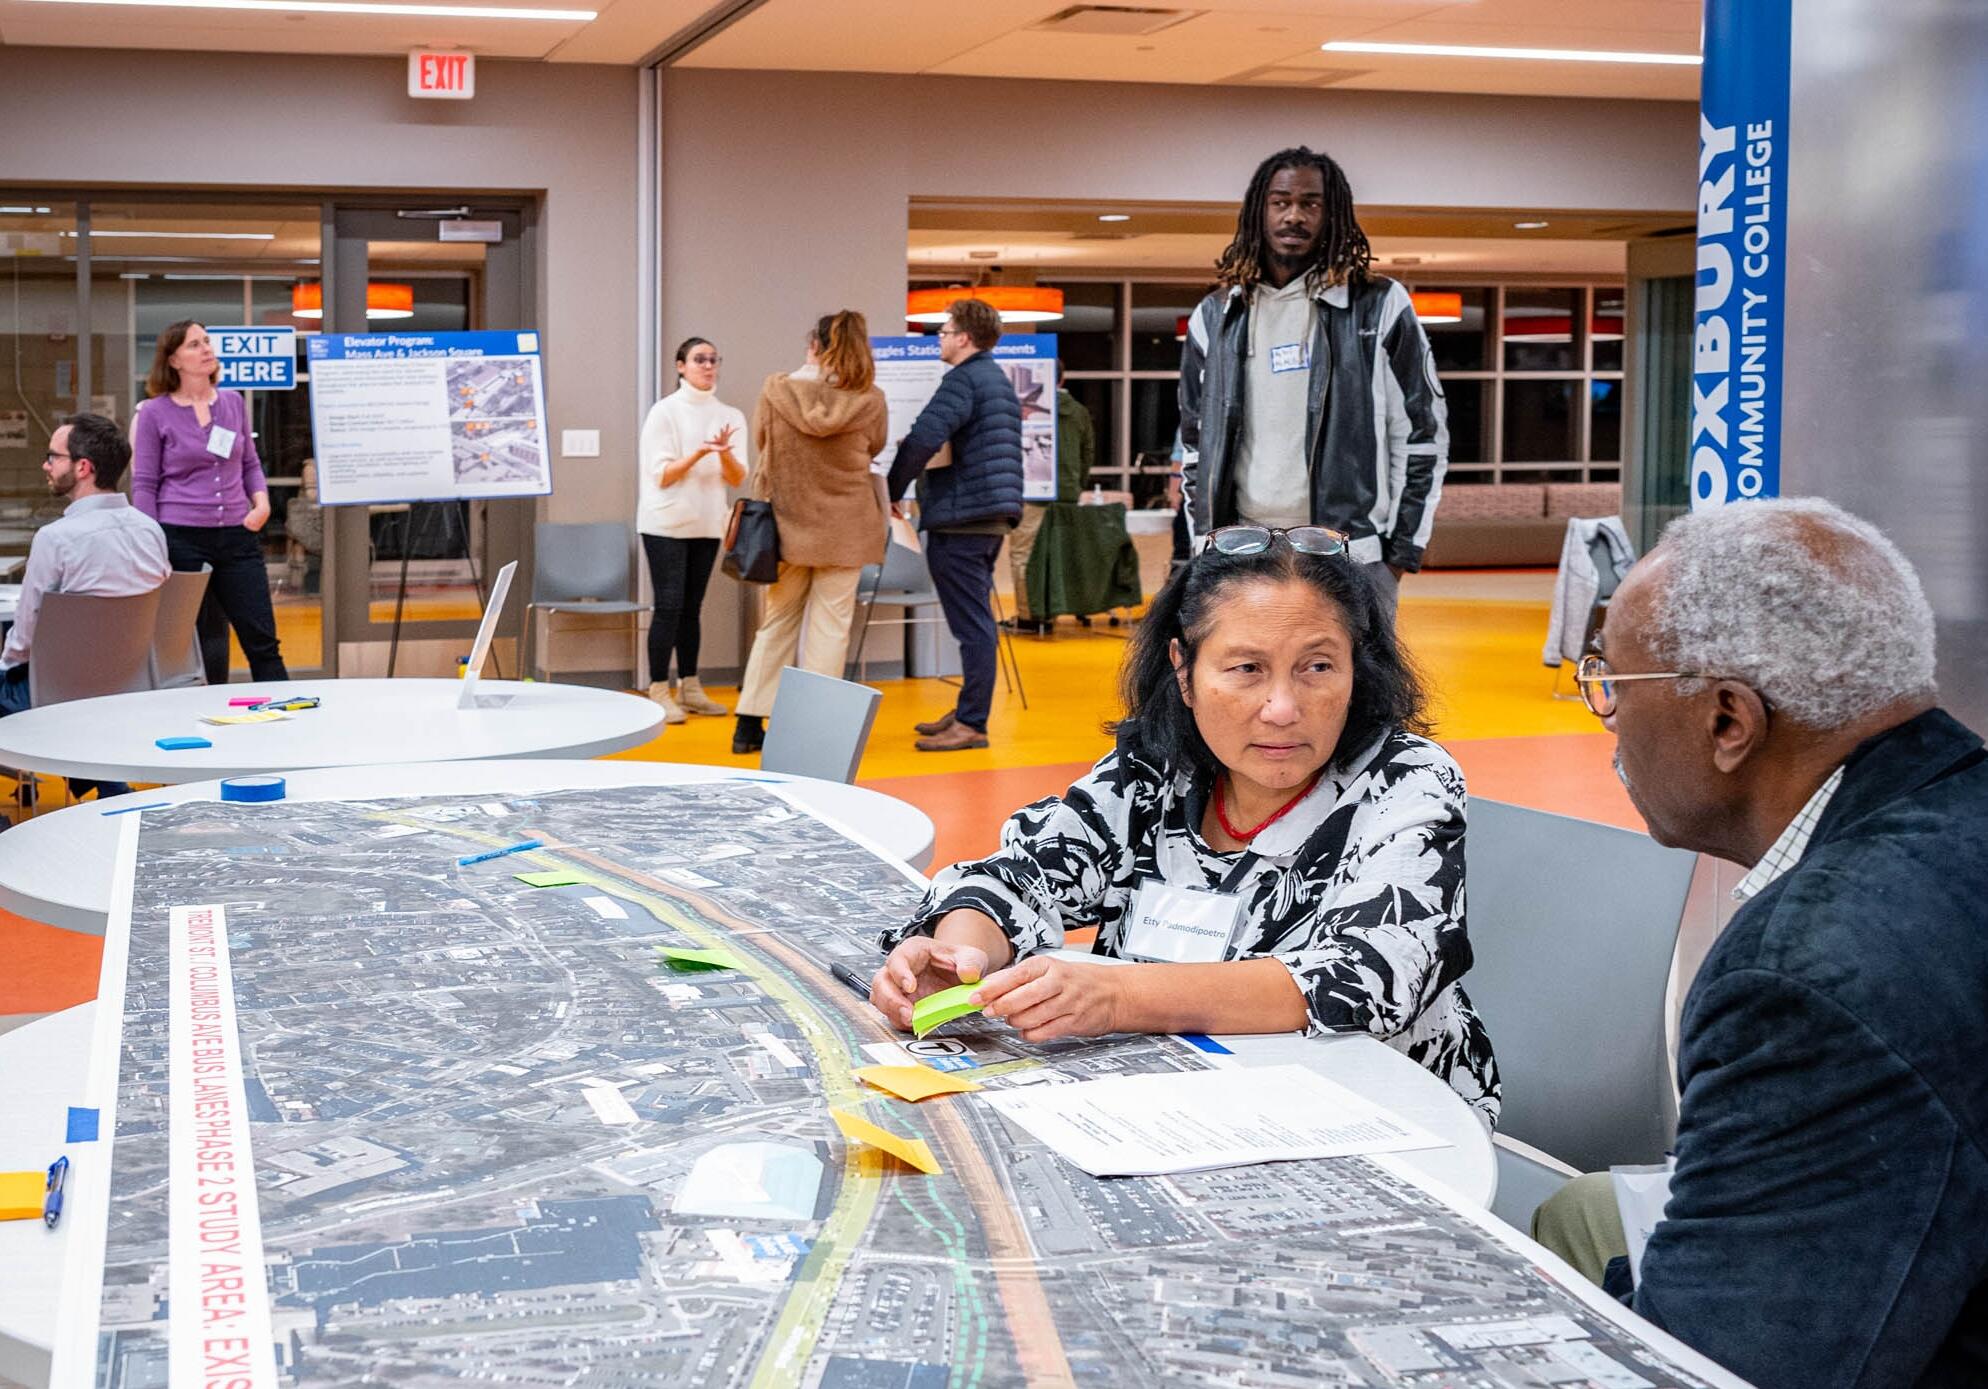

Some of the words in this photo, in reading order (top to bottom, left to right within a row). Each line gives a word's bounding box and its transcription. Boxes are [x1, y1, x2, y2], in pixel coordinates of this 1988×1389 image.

[420, 55, 468, 90] EXIT
[1743, 119, 1773, 278] COLLEGE
[1690, 111, 1736, 512] OXBURY
[222, 336, 278, 353] EXIT
[344, 336, 387, 347] Elevator
[388, 335, 435, 347] Program:
[408, 348, 447, 358] Jackson
[907, 344, 942, 356] Statio
[992, 344, 1037, 355] ements
[220, 361, 287, 381] HERE
[1737, 288, 1768, 501] OMMUNITY
[188, 909, 215, 945] TREMONT
[1143, 916, 1160, 929] Etty
[1162, 919, 1226, 938] admodipoetro
[188, 947, 216, 960] ST.
[189, 967, 222, 1020] COLUMBUS
[191, 1024, 223, 1046] AVE
[192, 1049, 226, 1073] BUS
[193, 1076, 231, 1118] LANES
[195, 1120, 235, 1172] PHASE
[198, 1178, 236, 1187] 2
[198, 1191, 242, 1254] STUDY
[200, 1263, 247, 1329] AREA:
